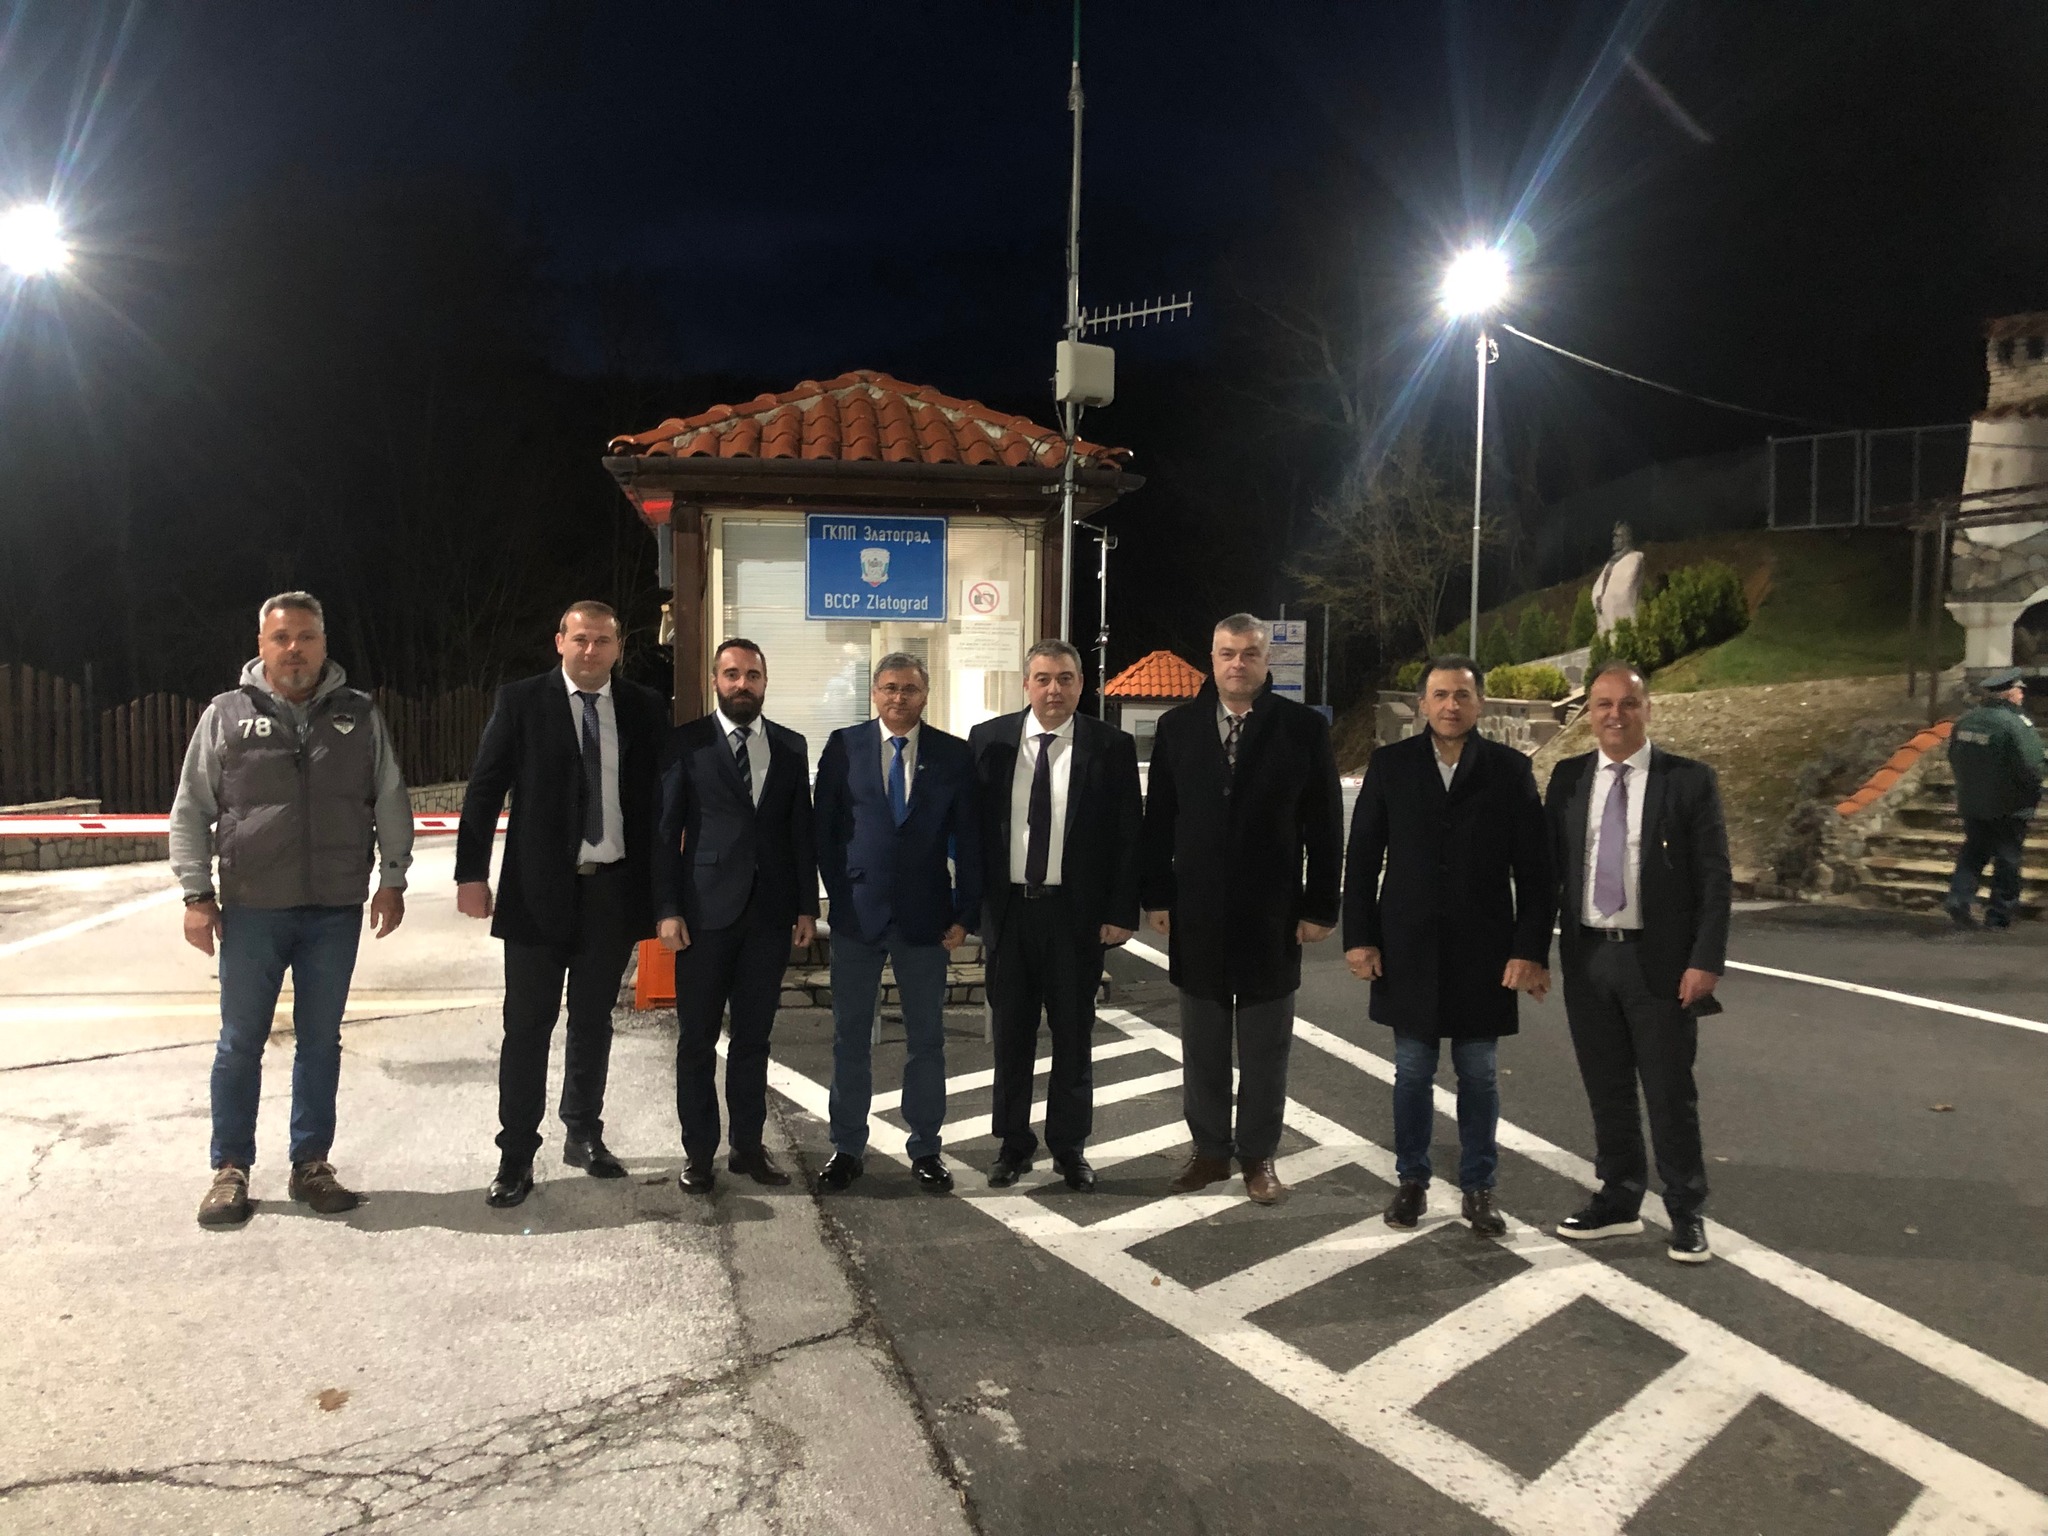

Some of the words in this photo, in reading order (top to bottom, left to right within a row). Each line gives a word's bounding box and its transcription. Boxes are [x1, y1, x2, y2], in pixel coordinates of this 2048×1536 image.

[822, 524, 857, 541] ГКПП
[863, 525, 931, 546] Златоград
[824, 593, 860, 609] BCCP
[866, 594, 929, 614] Zlatograd
[238, 717, 272, 739] 78
